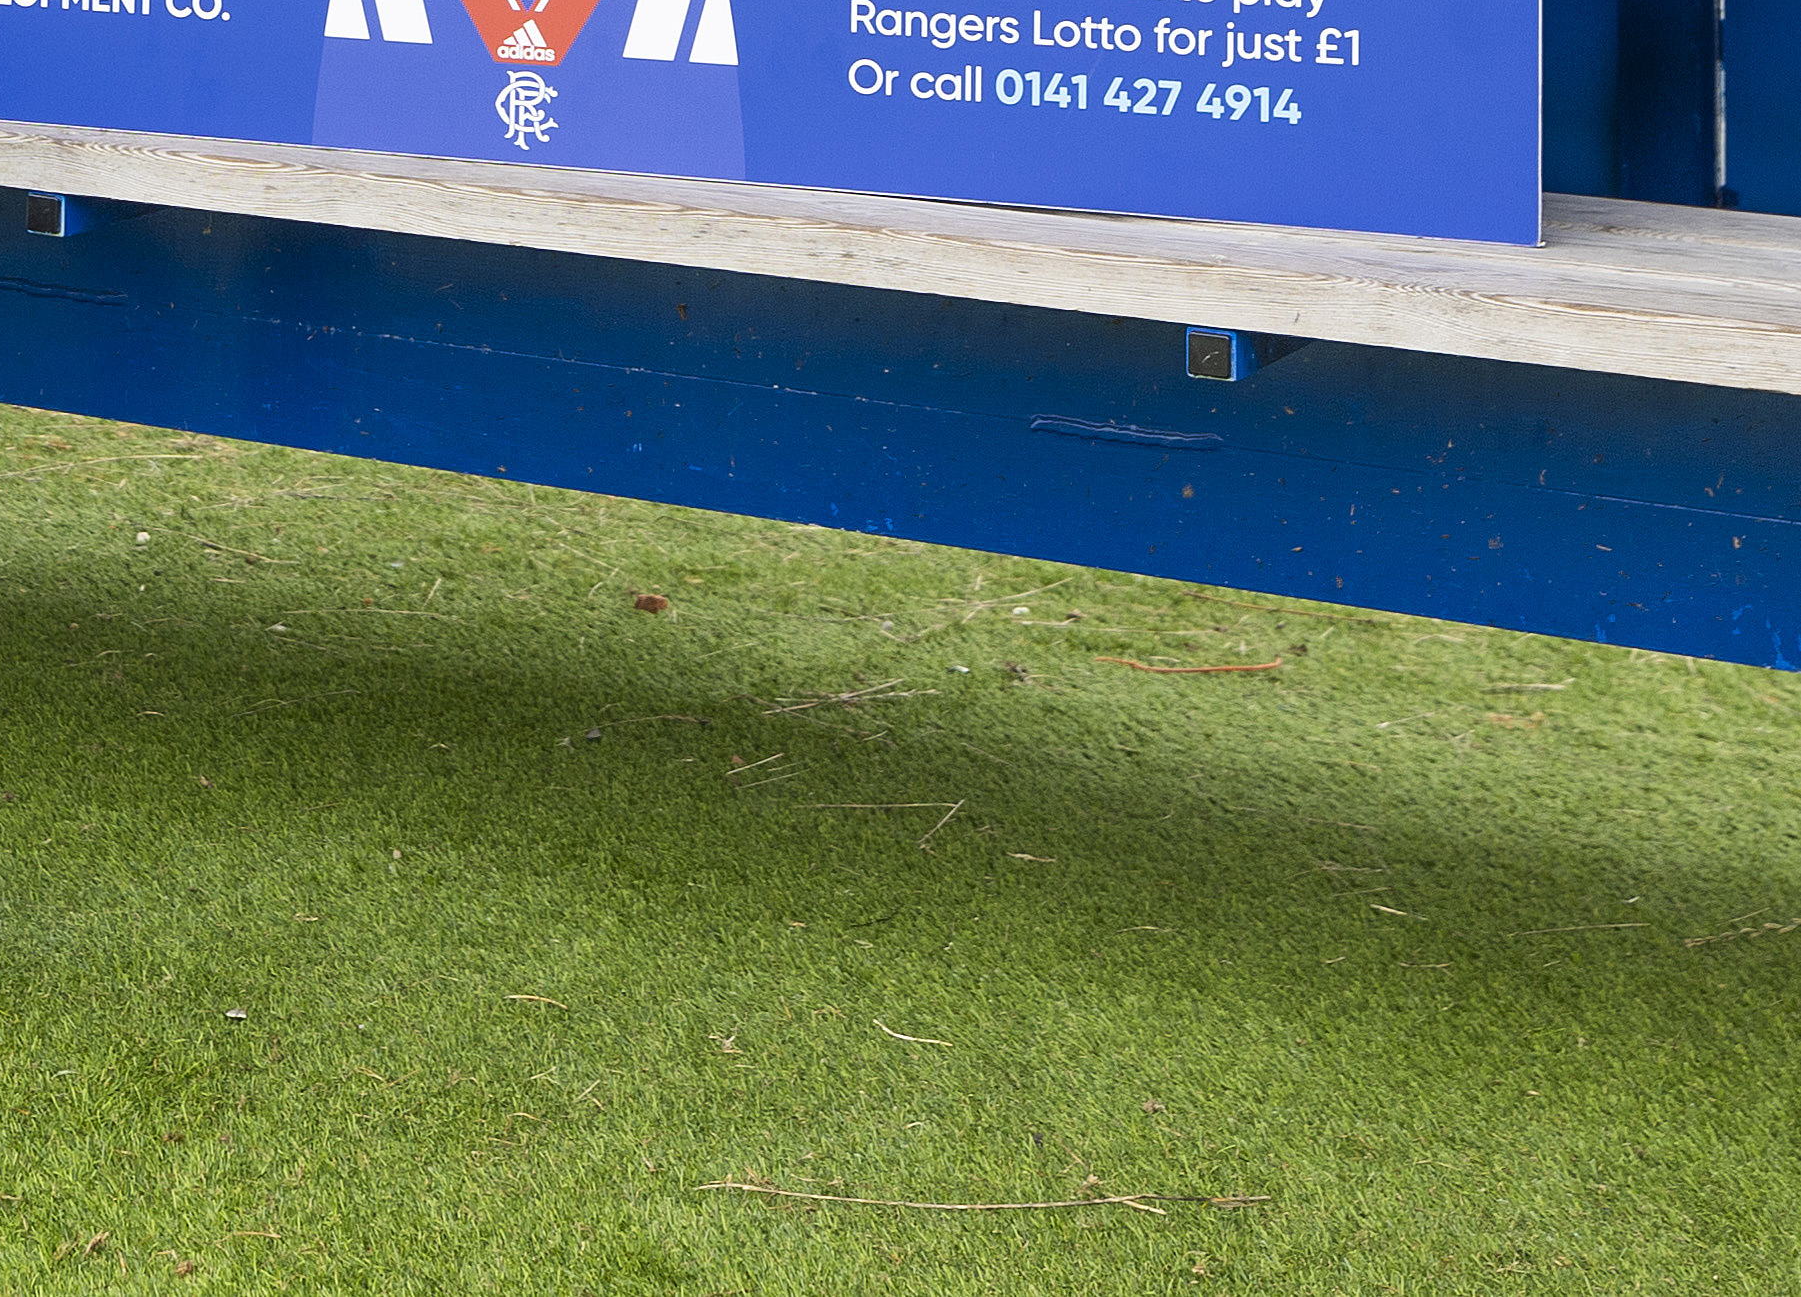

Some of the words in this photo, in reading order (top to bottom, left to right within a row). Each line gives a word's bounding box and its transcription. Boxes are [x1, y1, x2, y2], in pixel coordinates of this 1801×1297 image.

[496, 45, 556, 62] adidas
[1032, 10, 1142, 52] Lotto
[1153, 17, 1213, 57] for
[1222, 21, 1303, 68] just
[1315, 27, 1361, 66] £1
[847, 58, 899, 97] Or
[909, 64, 983, 103] call
[994, 68, 1089, 110] 0141
[1103, 76, 1183, 116] 427
[1195, 82, 1303, 125] 4914
